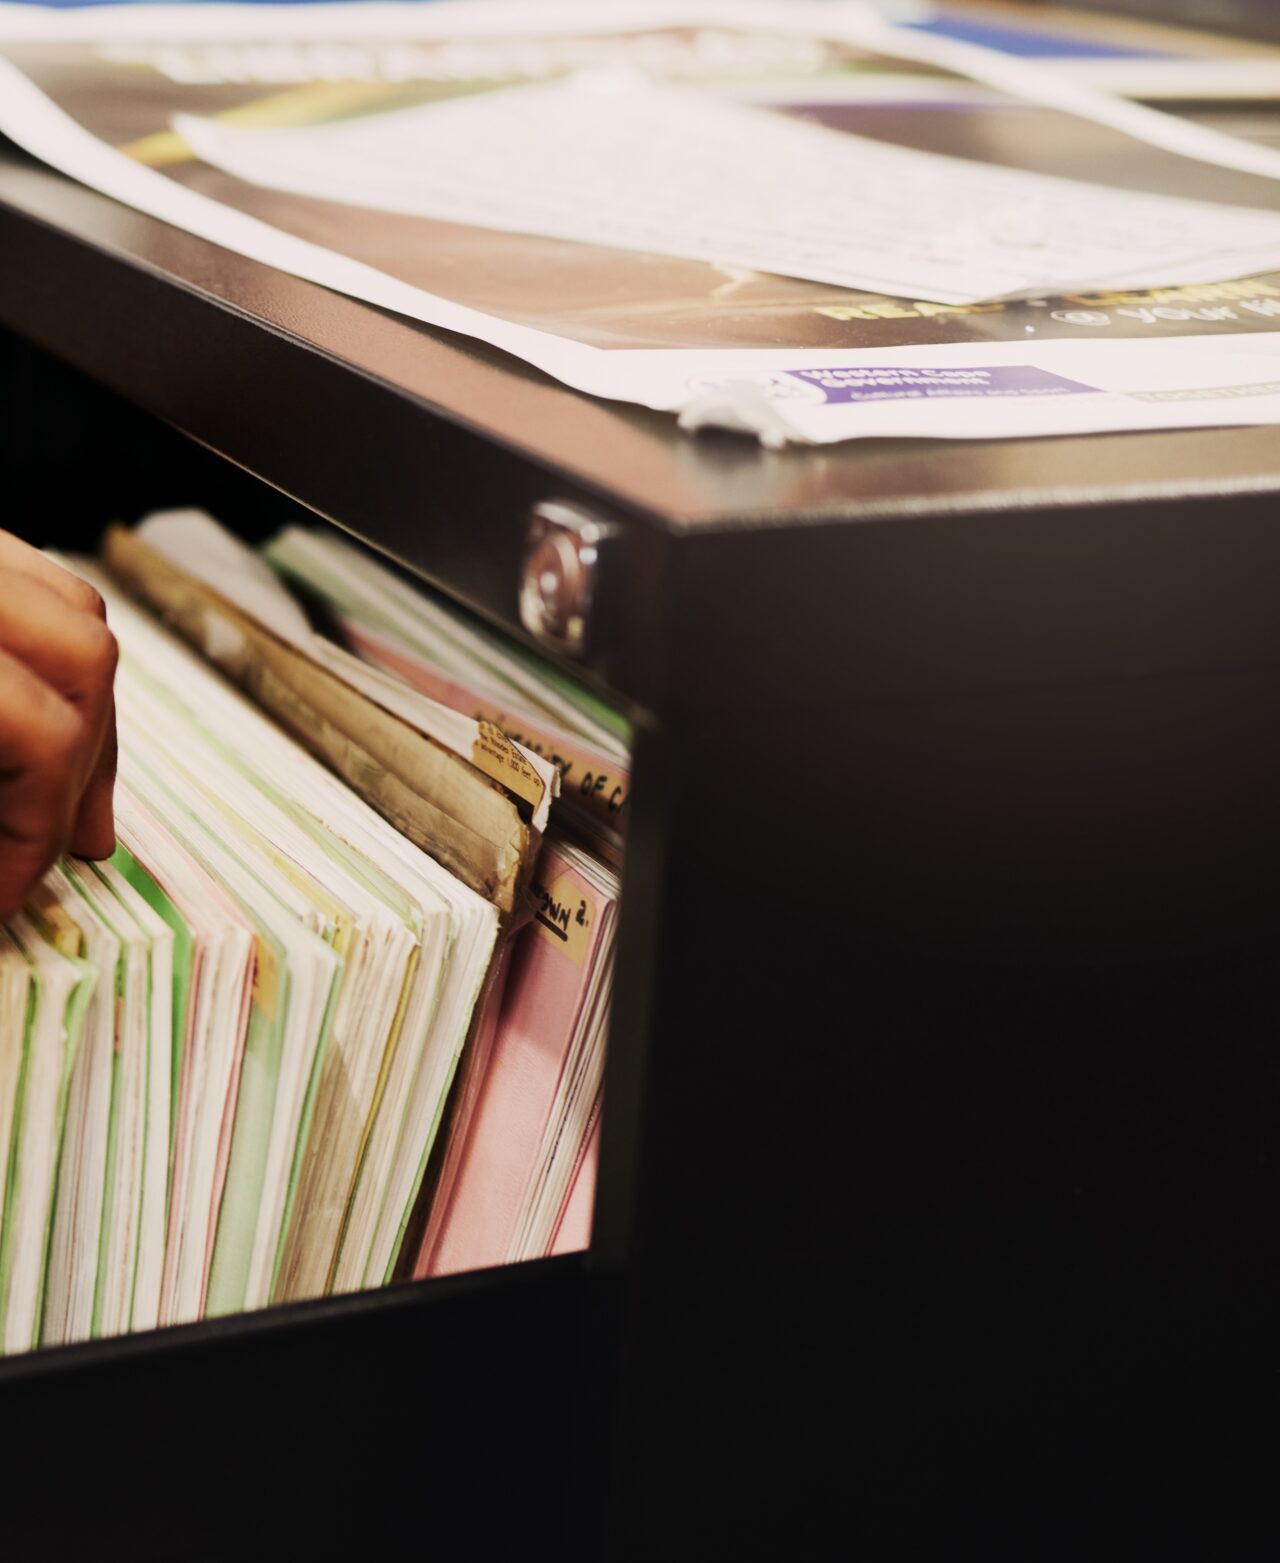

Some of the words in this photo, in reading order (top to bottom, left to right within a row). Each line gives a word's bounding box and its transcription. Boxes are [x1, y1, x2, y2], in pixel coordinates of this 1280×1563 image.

[799, 369, 919, 380] Western
[920, 369, 992, 379] Cape
[820, 376, 990, 388] Government
